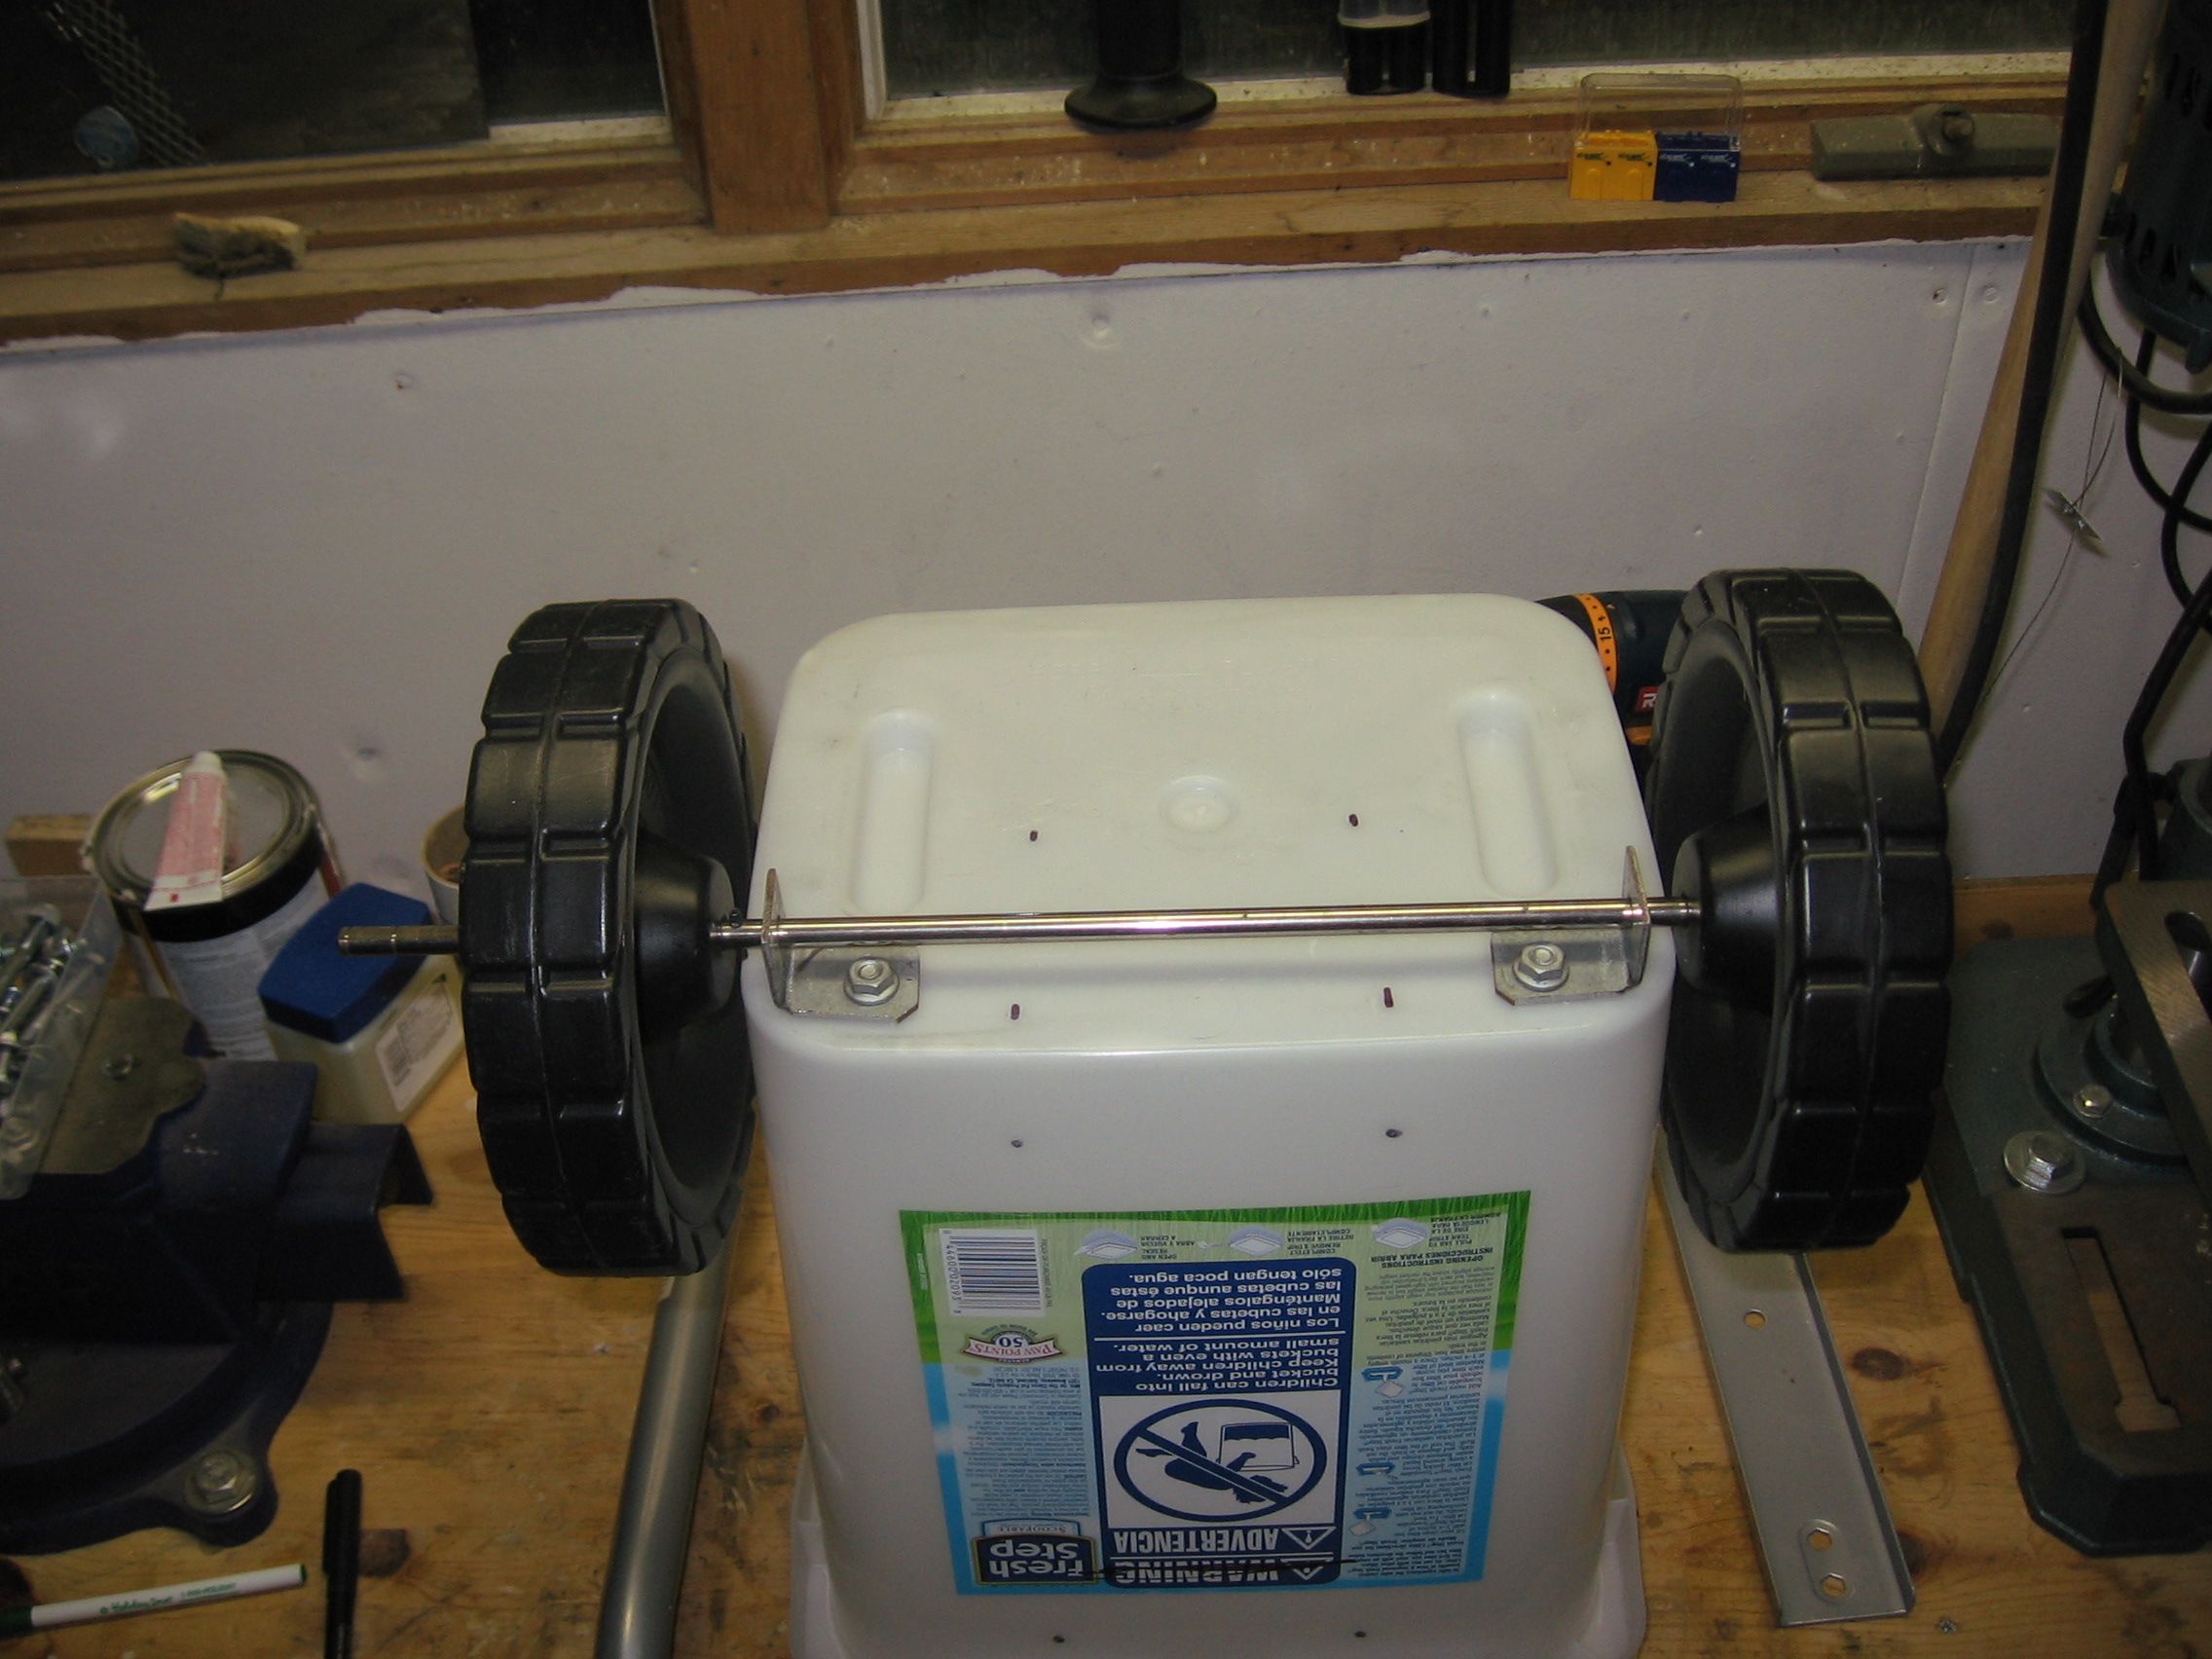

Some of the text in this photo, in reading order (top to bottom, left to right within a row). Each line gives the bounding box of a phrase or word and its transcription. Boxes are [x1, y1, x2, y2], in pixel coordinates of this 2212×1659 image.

[1128, 1268, 1342, 1283] sólo tengan poca agua.
[1110, 1281, 1341, 1298] las cubetas aunque éstas
[1116, 1293, 1341, 1309] Manténgalos alejados de
[1101, 1307, 1341, 1322] en las cubetas y ahogarse.
[1180, 1319, 1246, 1332] pueden
[1251, 1319, 1301, 1330] niños
[1307, 1318, 1340, 1328] Los
[999, 1337, 1022, 1347] 50
[1114, 1338, 1340, 1353] small amount of water.
[1213, 1351, 1254, 1361] with
[1260, 1347, 1339, 1359] buckets
[1096, 1356, 1338, 1373] Keep children away from
[1157, 1368, 1339, 1382] bucket and drown.
[1135, 1378, 1338, 1392] Children can fall into
[1114, 1529, 1279, 1554] ADVERTENCIA
[989, 1539, 1079, 1560] Step
[989, 1560, 1083, 1577] Fresh
